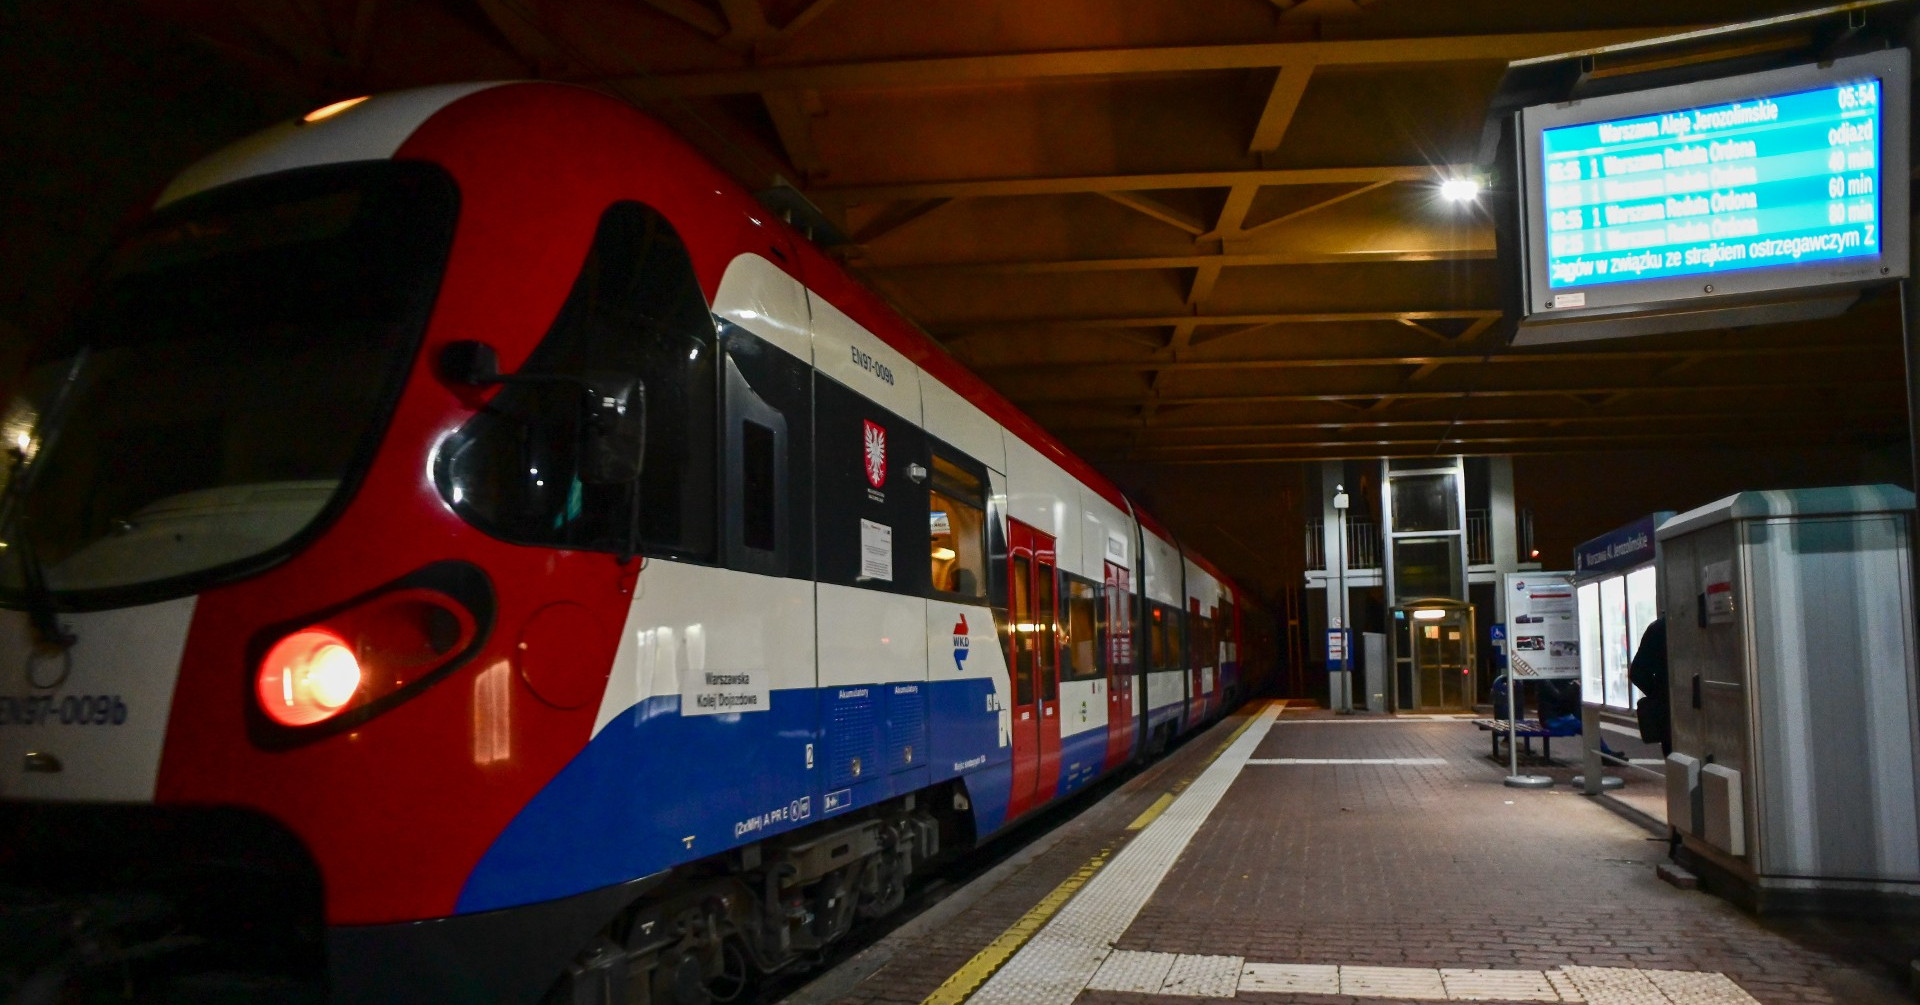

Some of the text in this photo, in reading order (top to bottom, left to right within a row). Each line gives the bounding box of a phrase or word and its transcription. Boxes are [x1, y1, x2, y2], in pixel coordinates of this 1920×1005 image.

[1838, 84, 1876, 109] 05:54
[1599, 100, 1778, 144] Warszawa Aleje Jerozolimskie
[1709, 138, 1757, 163] Ordona
[1828, 118, 1874, 146] odjazd
[1848, 147, 1874, 169] min
[1711, 189, 1757, 213] Ordona
[1828, 175, 1845, 198] 60
[1848, 172, 1873, 196] min
[1848, 199, 1874, 222] min
[1596, 259, 1608, 274] w
[1611, 250, 1662, 275] związku
[1665, 250, 1682, 268] ze
[1685, 241, 1746, 267] strajkiem
[1750, 230, 1860, 259] ostrzegawczym
[1864, 225, 1875, 246] Z
[851, 345, 895, 386] EN97-009b
[953, 636, 970, 648] WKD
[705, 672, 750, 685] Warszawska
[697, 692, 757, 710] Kolej Dojazdowa
